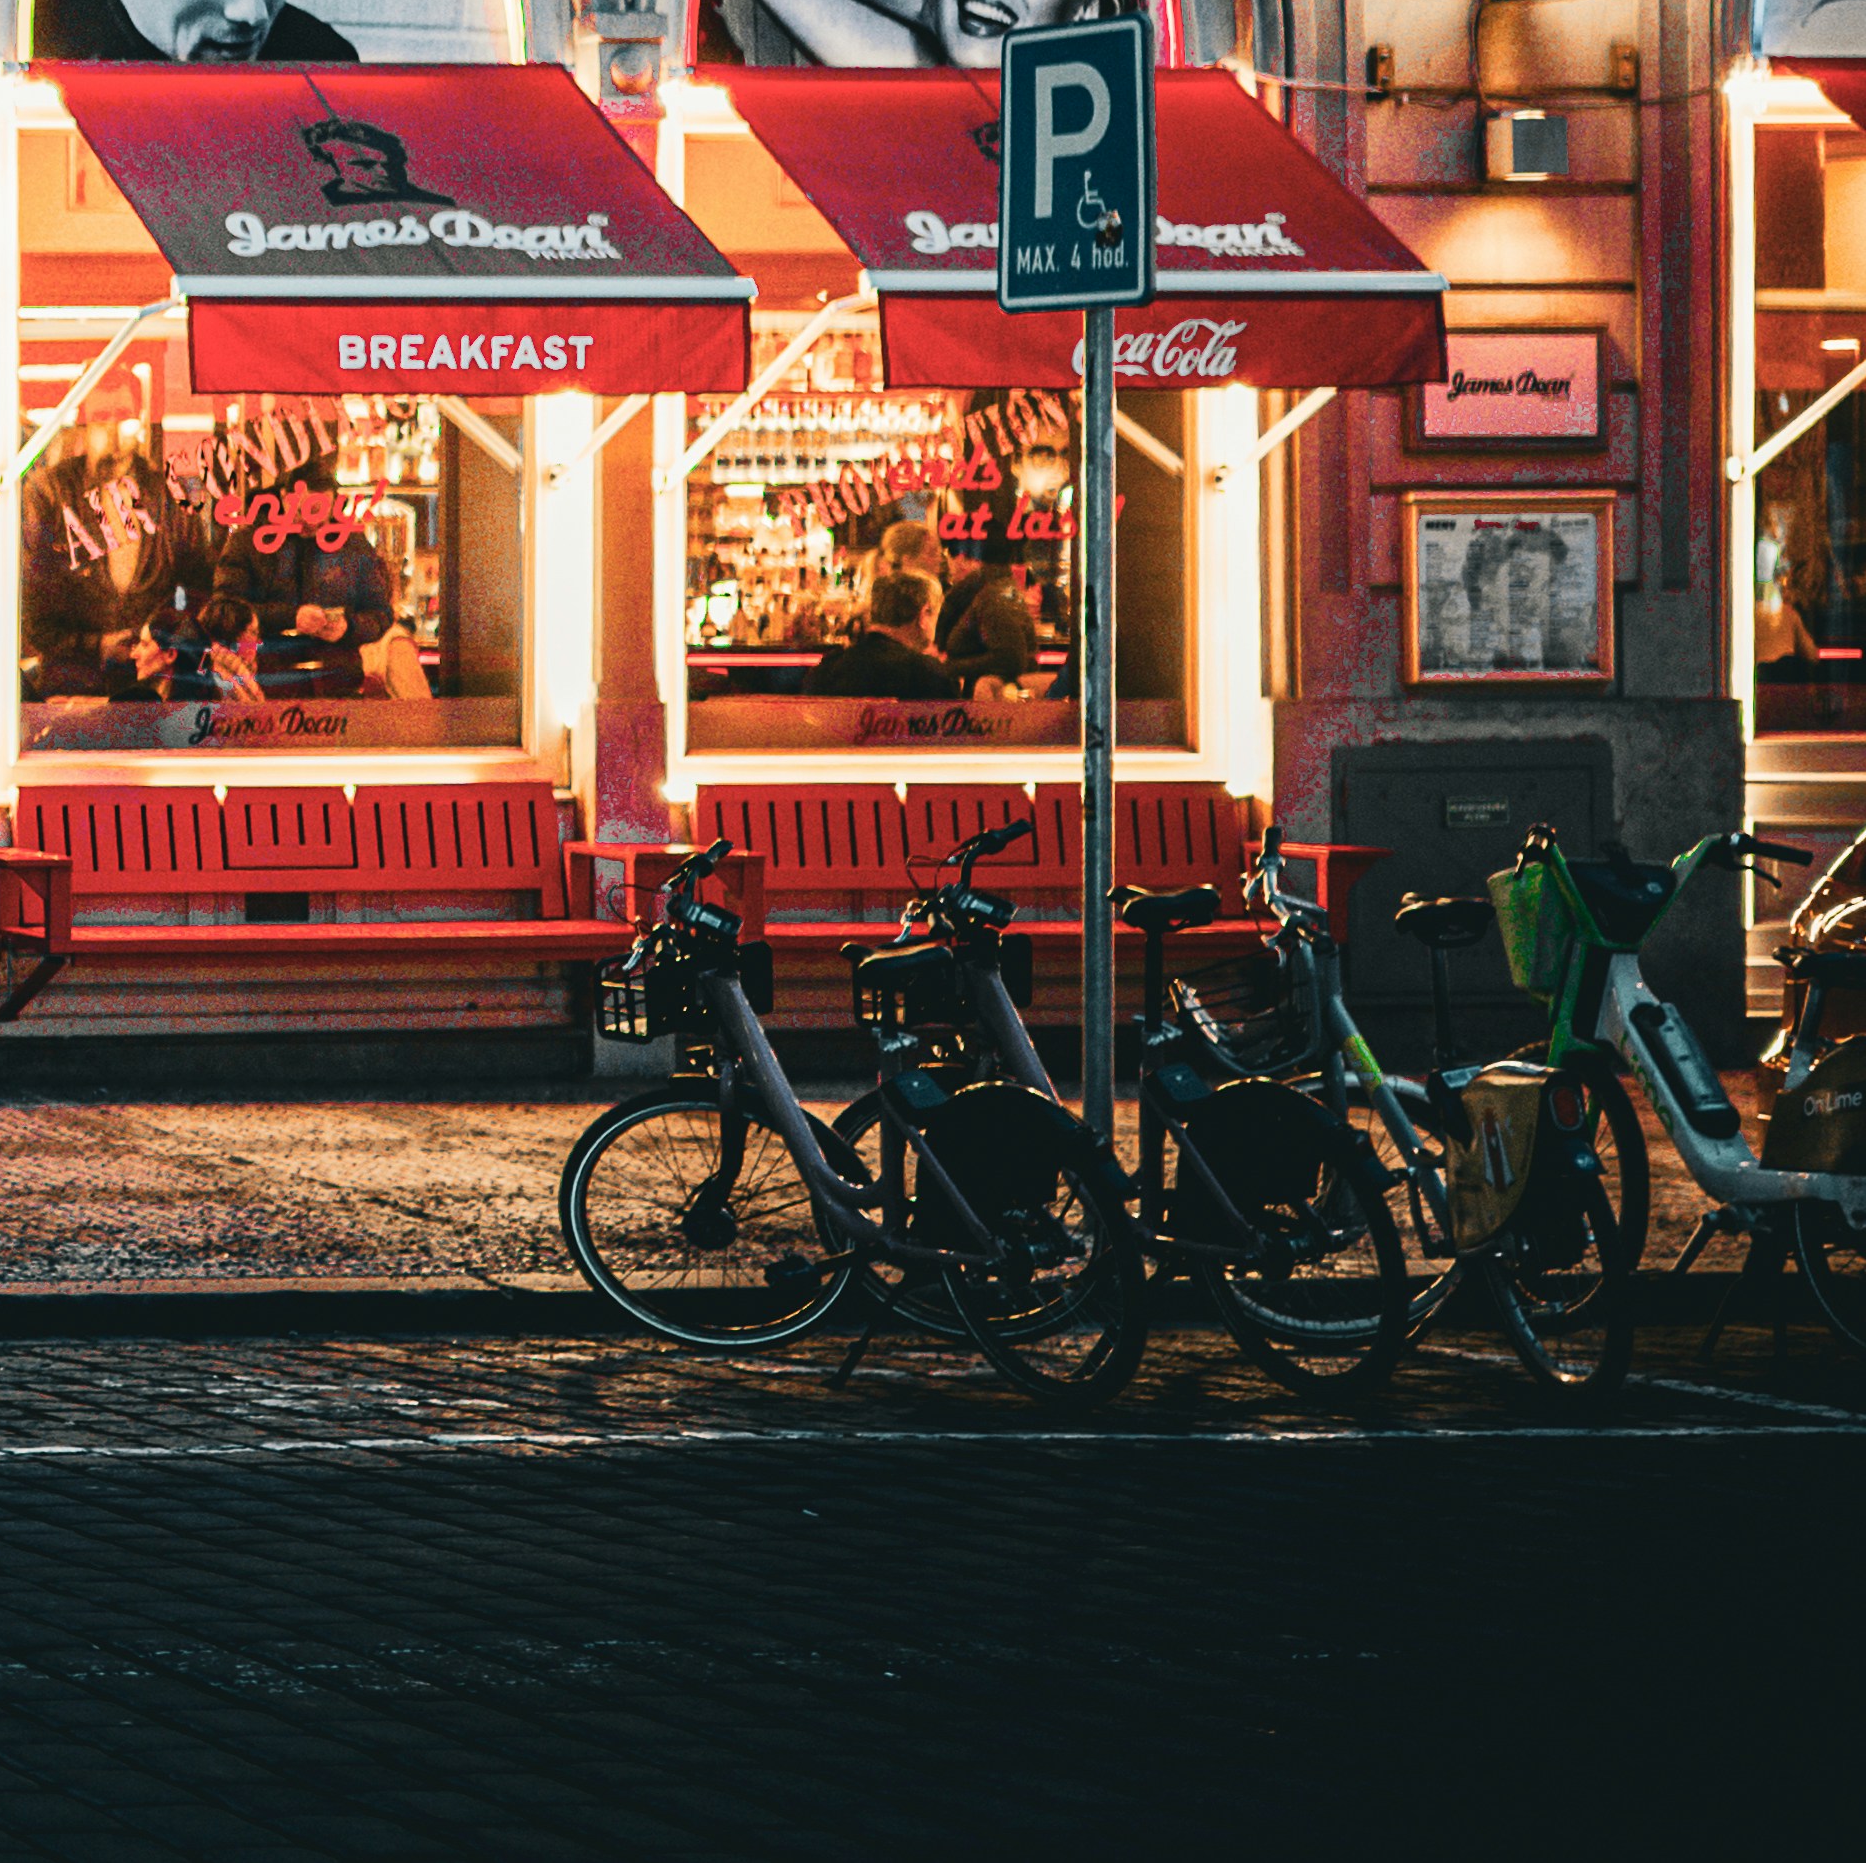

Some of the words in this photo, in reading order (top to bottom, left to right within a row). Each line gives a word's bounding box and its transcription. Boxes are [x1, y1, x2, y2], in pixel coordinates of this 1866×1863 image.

[1033, 60, 1112, 219] P
[225, 211, 430, 257] James
[428, 209, 611, 250] Dean
[1016, 244, 1060, 276] MAX.
[1070, 240, 1082, 271] 4
[1092, 240, 1129, 270] hod.
[338, 333, 594, 371] BREAKFAST
[1071, 318, 1248, 377] ca-Cola
[1447, 366, 1514, 402] James
[1516, 366, 1570, 396] Dean
[214, 479, 389, 554] enjoy!
[938, 501, 993, 541] at
[1006, 490, 1126, 541] las!
[188, 706, 273, 745] James
[279, 705, 348, 735] Dean
